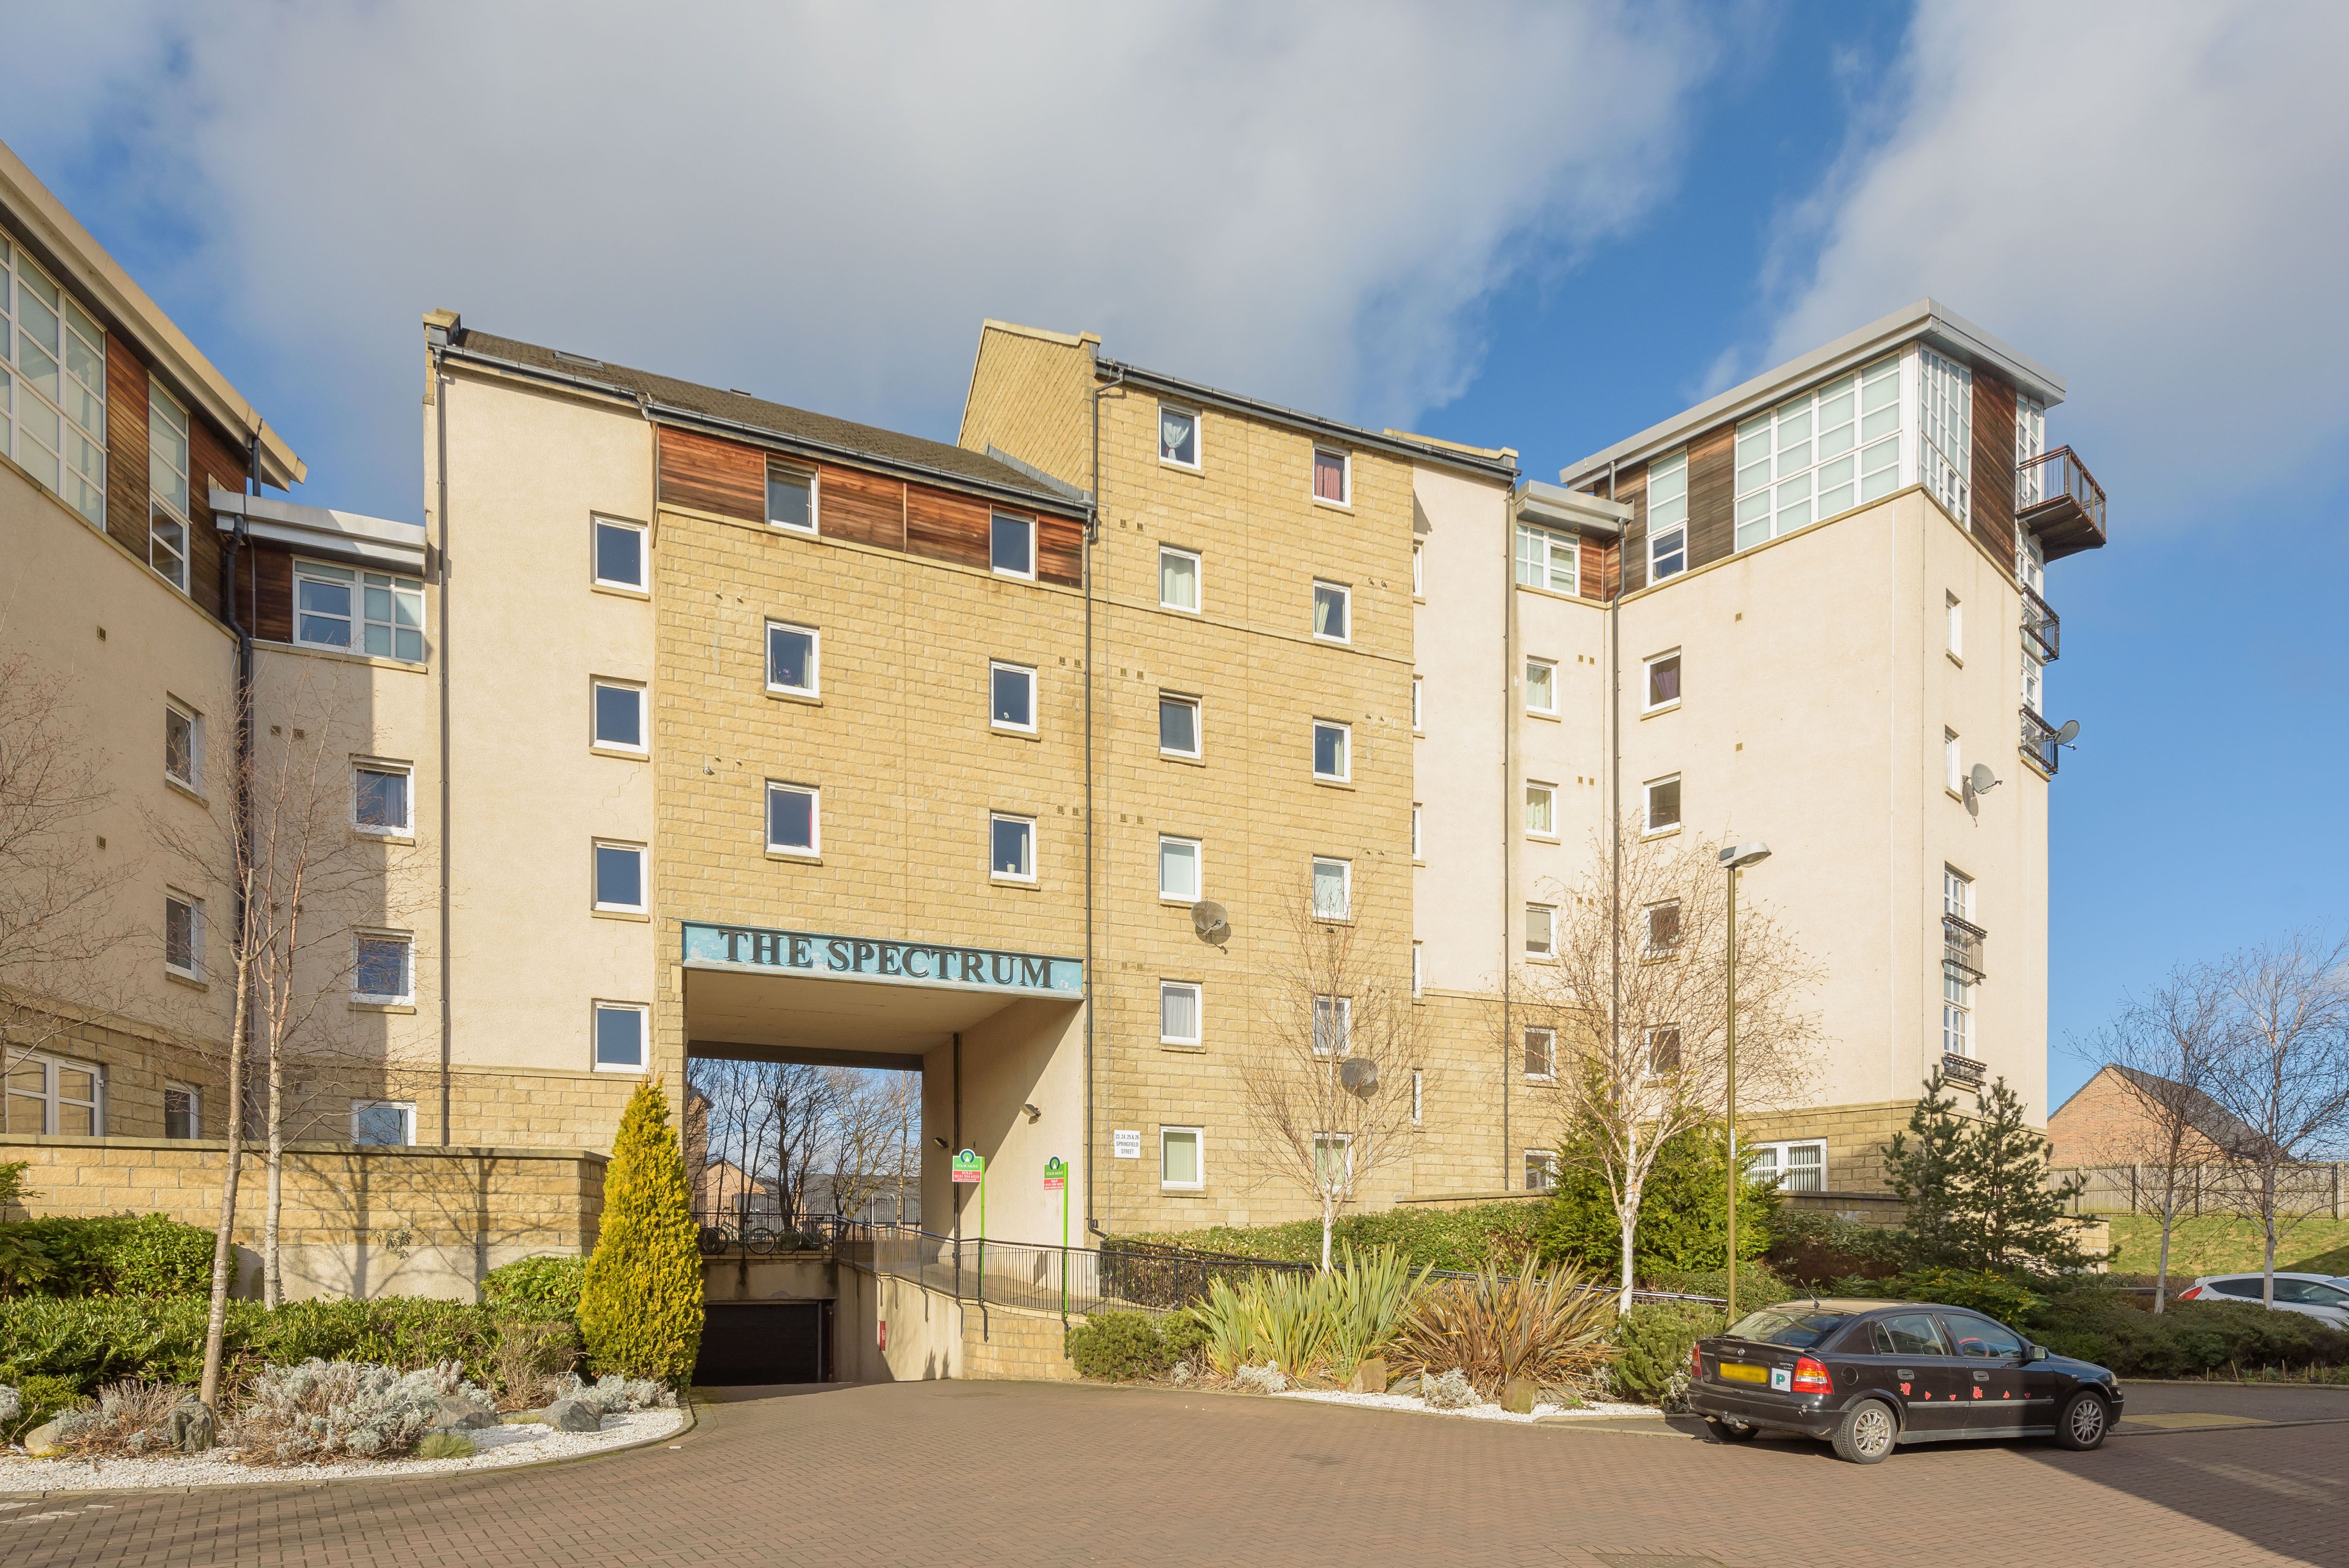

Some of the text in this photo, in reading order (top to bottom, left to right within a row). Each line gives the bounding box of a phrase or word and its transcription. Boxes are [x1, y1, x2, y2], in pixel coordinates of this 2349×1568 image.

[718, 929, 1054, 988] THE SPECTRUM
[1776, 1373, 1786, 1385] P
